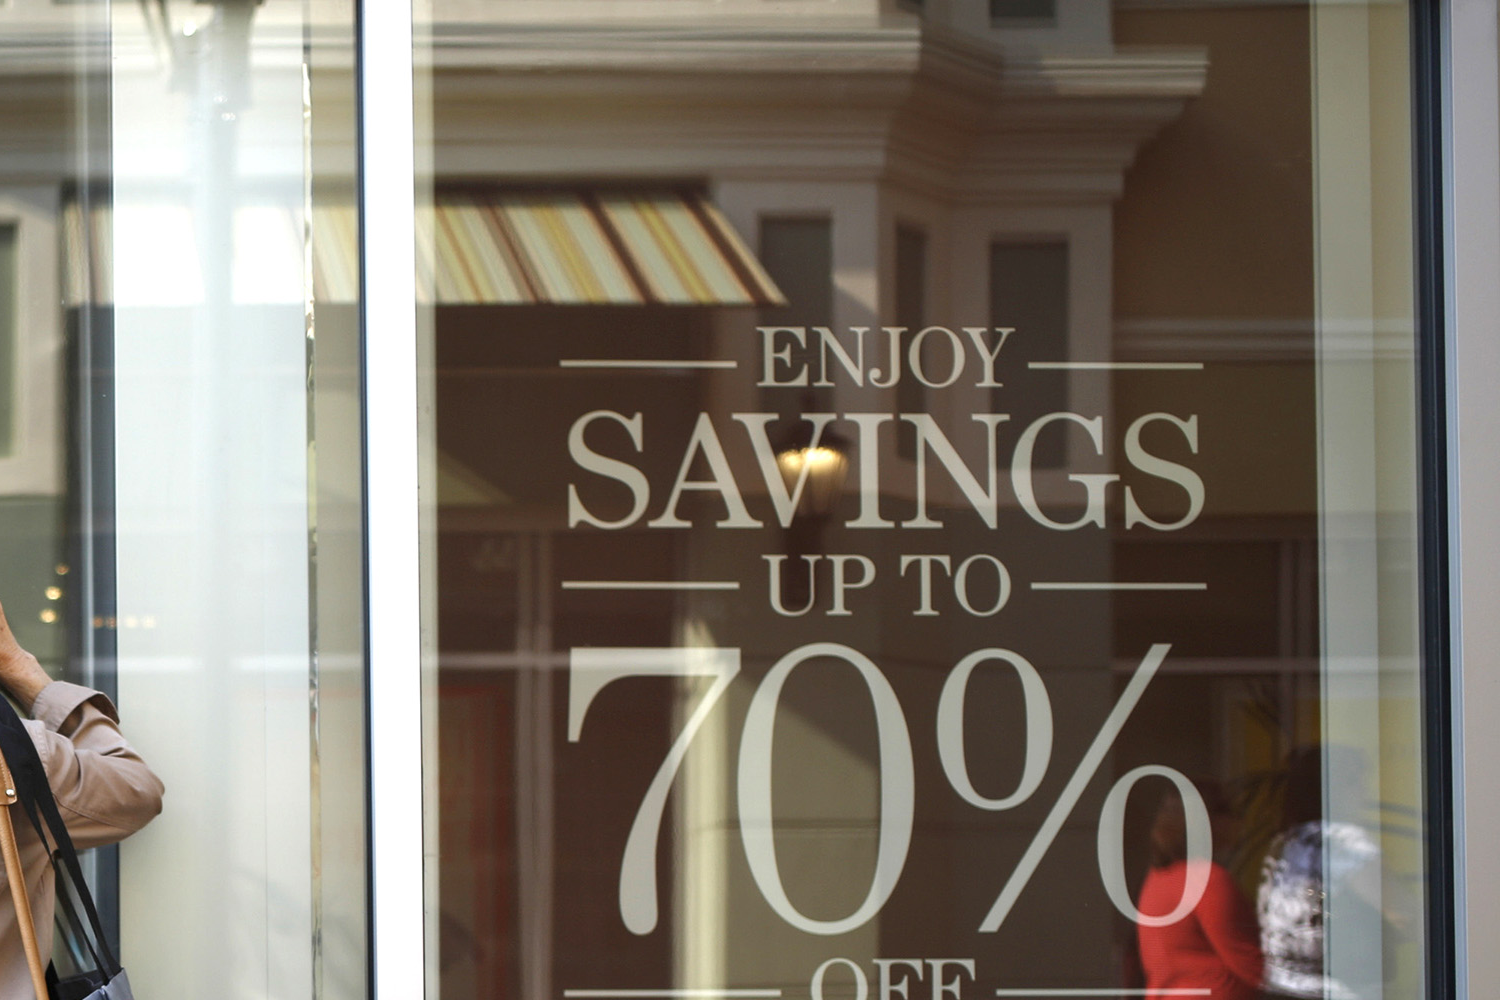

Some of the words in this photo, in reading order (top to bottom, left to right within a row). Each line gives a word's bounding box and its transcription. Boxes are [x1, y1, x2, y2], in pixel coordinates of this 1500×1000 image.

[757, 326, 1014, 388] ENJOY
[567, 410, 1206, 531] SAVINGS
[763, 554, 876, 617] UP
[900, 554, 1012, 617] TO
[568, 642, 1213, 936] 70%
